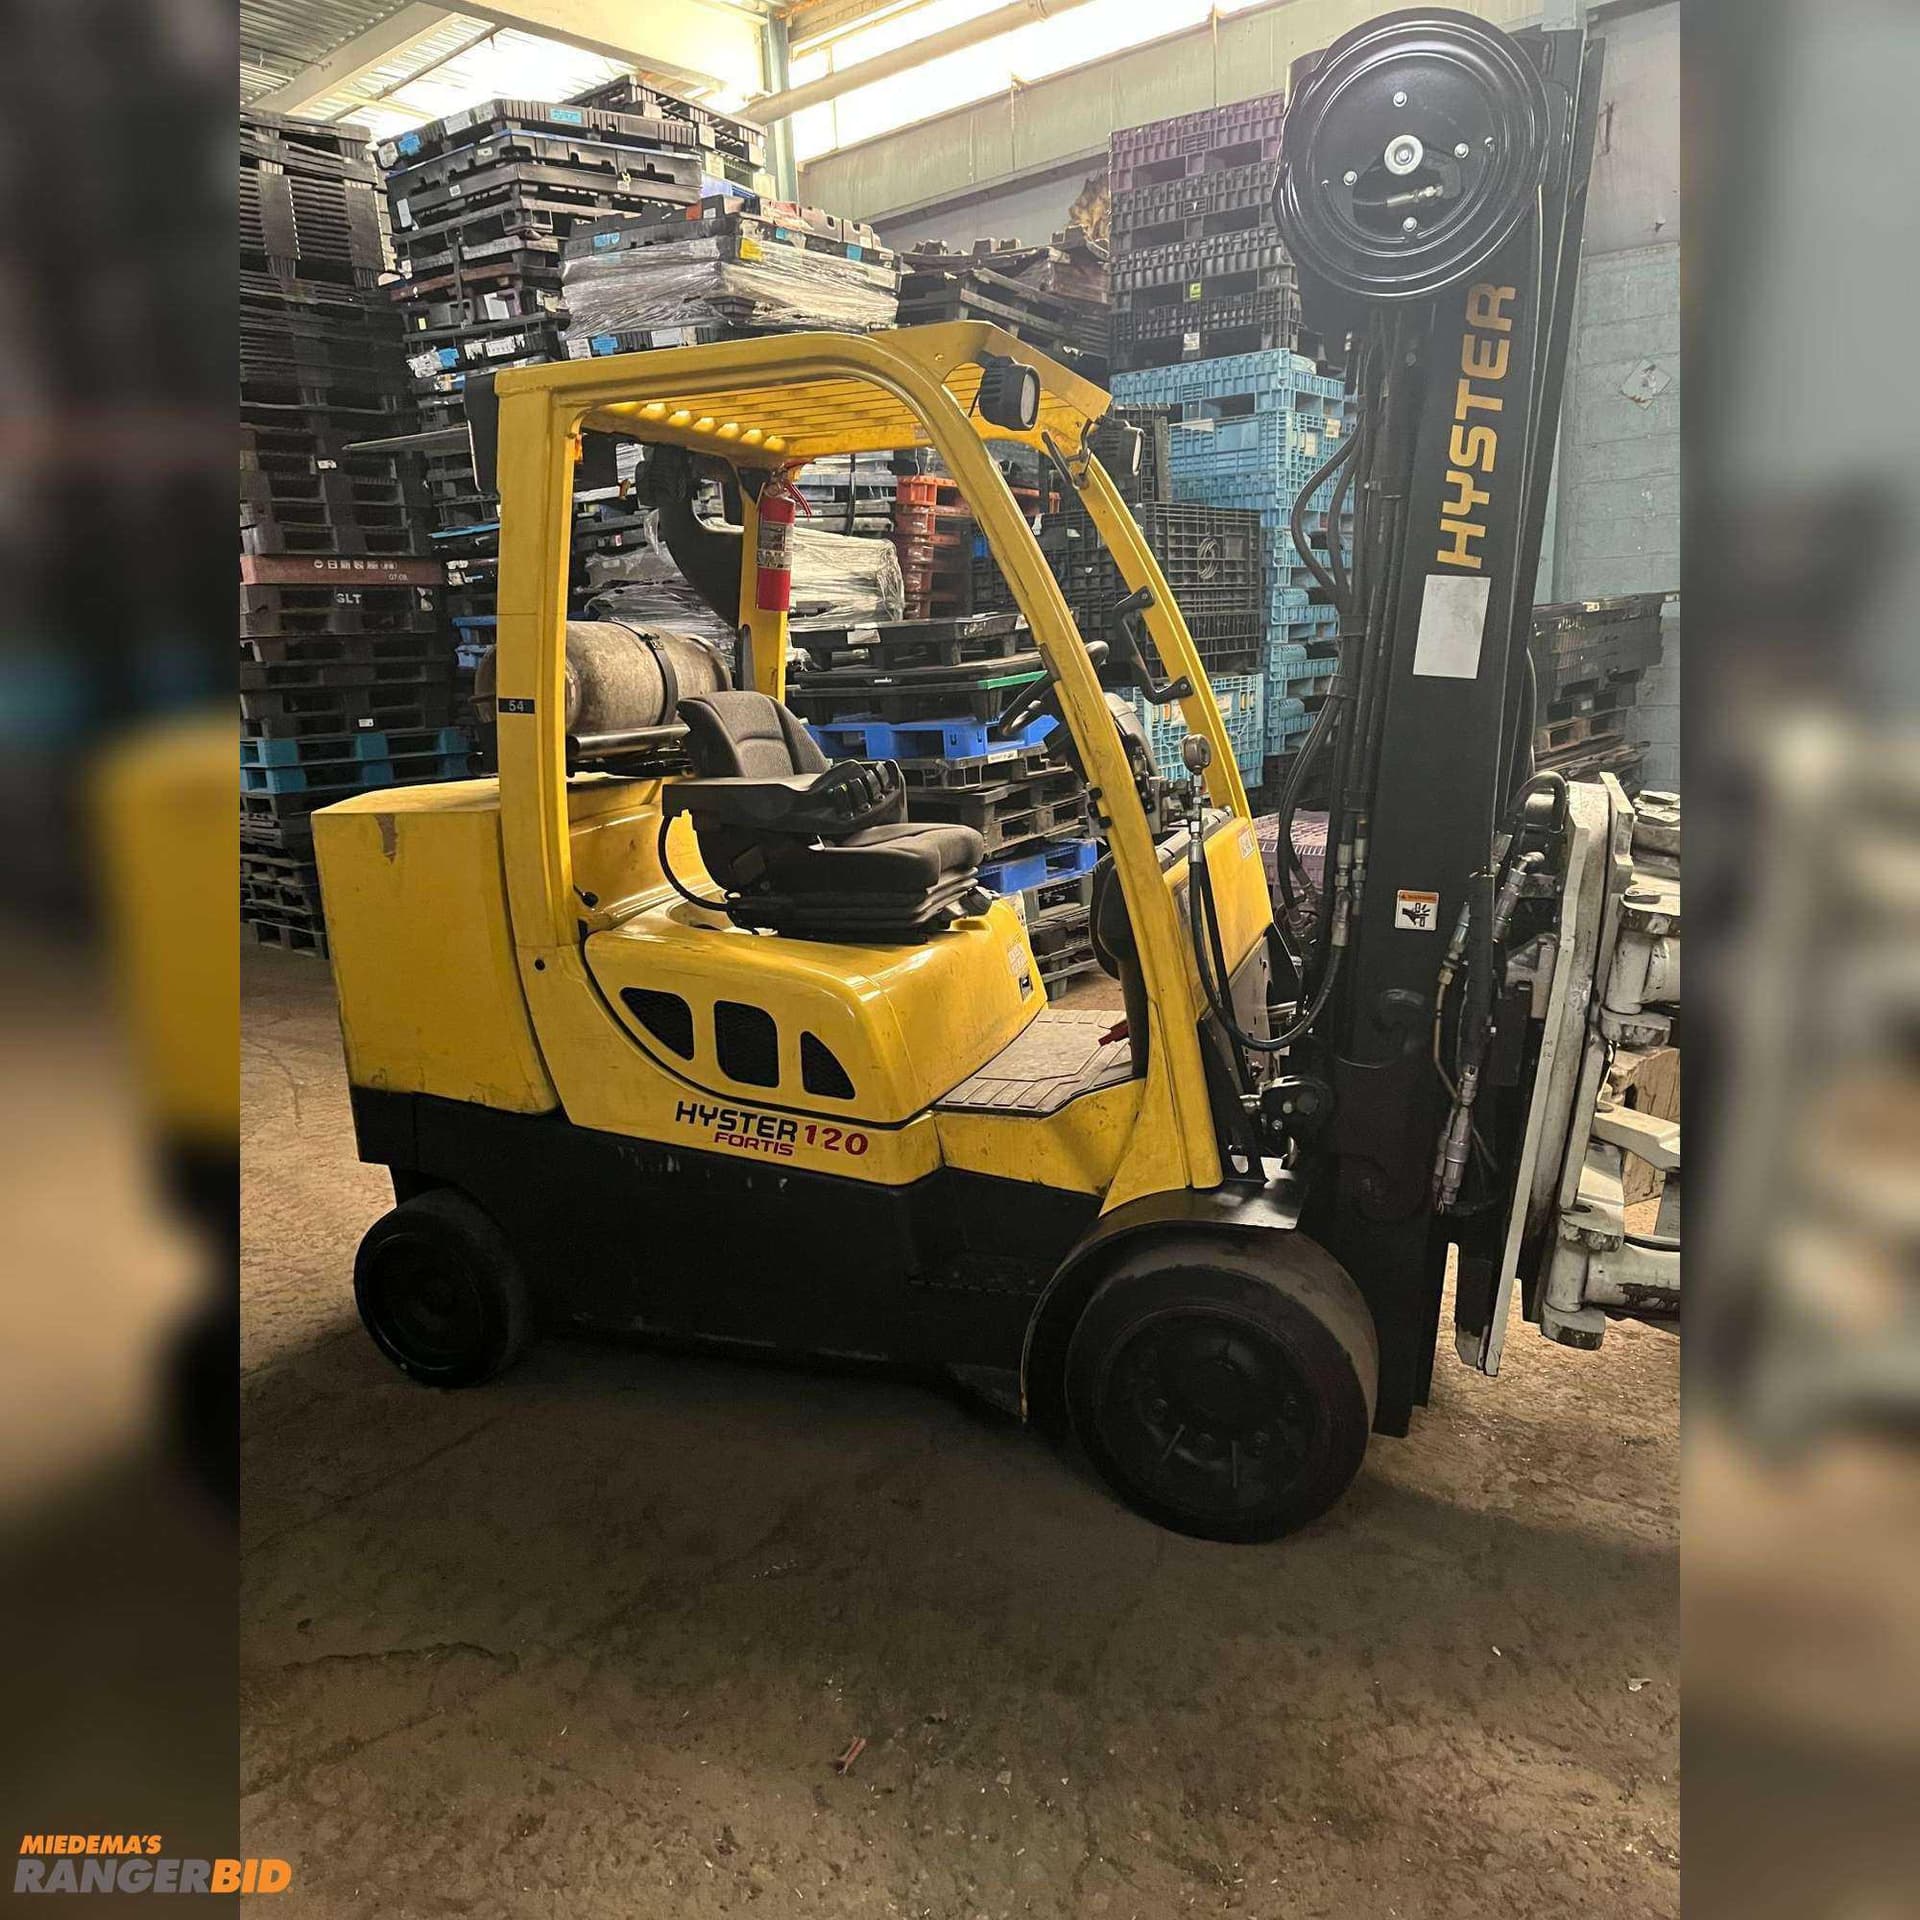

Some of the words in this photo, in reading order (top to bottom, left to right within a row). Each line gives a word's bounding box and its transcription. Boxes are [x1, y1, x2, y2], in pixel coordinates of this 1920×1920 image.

[1436, 283, 1516, 569] HYSTER
[336, 593, 361, 604] SLT
[509, 700, 525, 712] 54
[675, 1101, 798, 1143] HYSTER
[805, 1124, 869, 1156] 120
[714, 1131, 795, 1157] FORTIS
